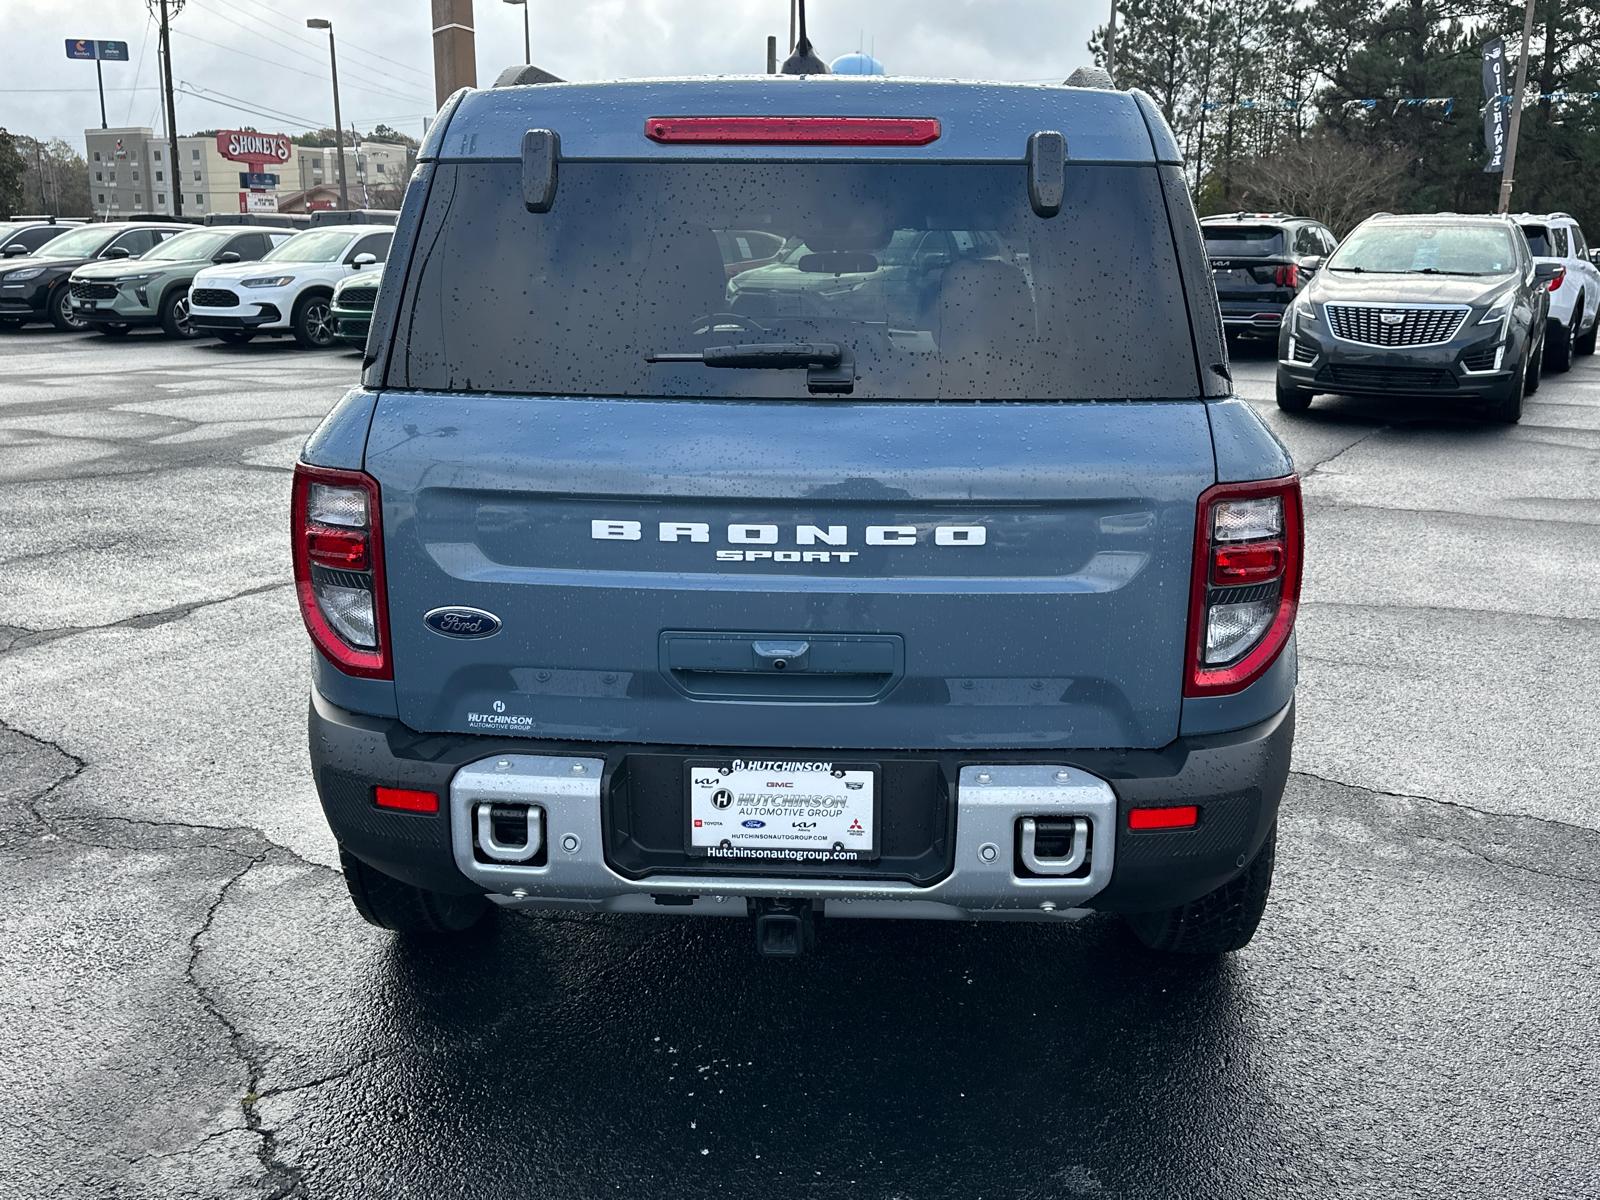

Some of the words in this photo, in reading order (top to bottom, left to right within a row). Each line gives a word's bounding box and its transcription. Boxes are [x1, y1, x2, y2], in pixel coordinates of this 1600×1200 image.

[228, 134, 289, 160] SHONEY'S
[591, 519, 987, 546] BRONCO
[716, 550, 859, 563] SPORT
[440, 612, 482, 632] Ford
[467, 714, 533, 725] HUTCHINSON
[469, 722, 508, 730] AUTOMOTIVE
[747, 761, 832, 772] HUTCHINSON
[736, 793, 848, 809] HUTCHINSON
[738, 807, 805, 817] AUTOMOTIVE
[807, 809, 843, 818] GROUP
[731, 833, 828, 841] HUTCHINSONAUTOGROUP.COM
[707, 847, 858, 861] Hutchinsonautogroup.com
